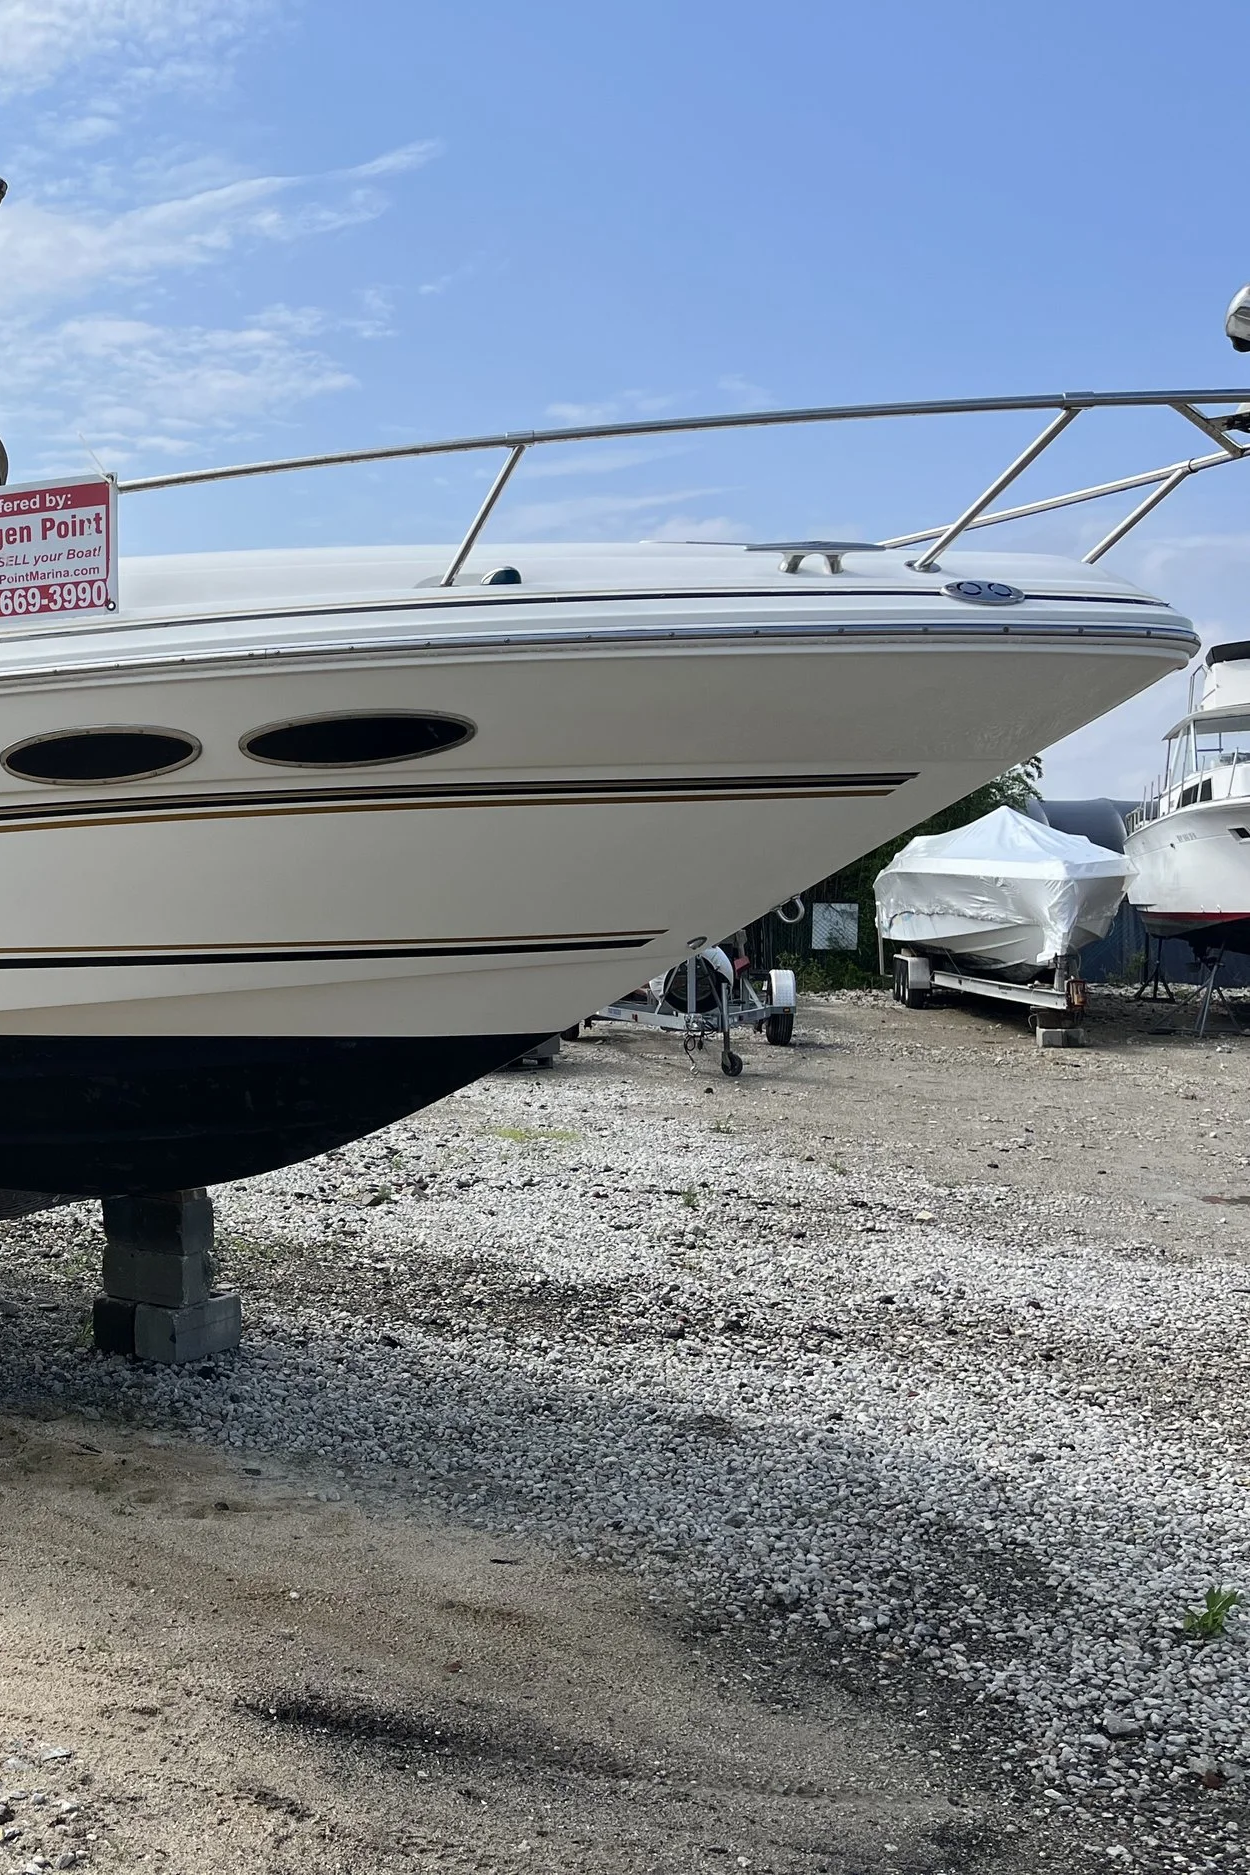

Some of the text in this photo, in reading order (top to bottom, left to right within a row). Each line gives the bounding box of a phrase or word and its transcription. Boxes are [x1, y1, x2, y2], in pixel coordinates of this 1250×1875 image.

[46, 492, 72, 510] by:
[41, 512, 103, 540] Point
[33, 552, 64, 566] your
[66, 545, 102, 560] Boat!
